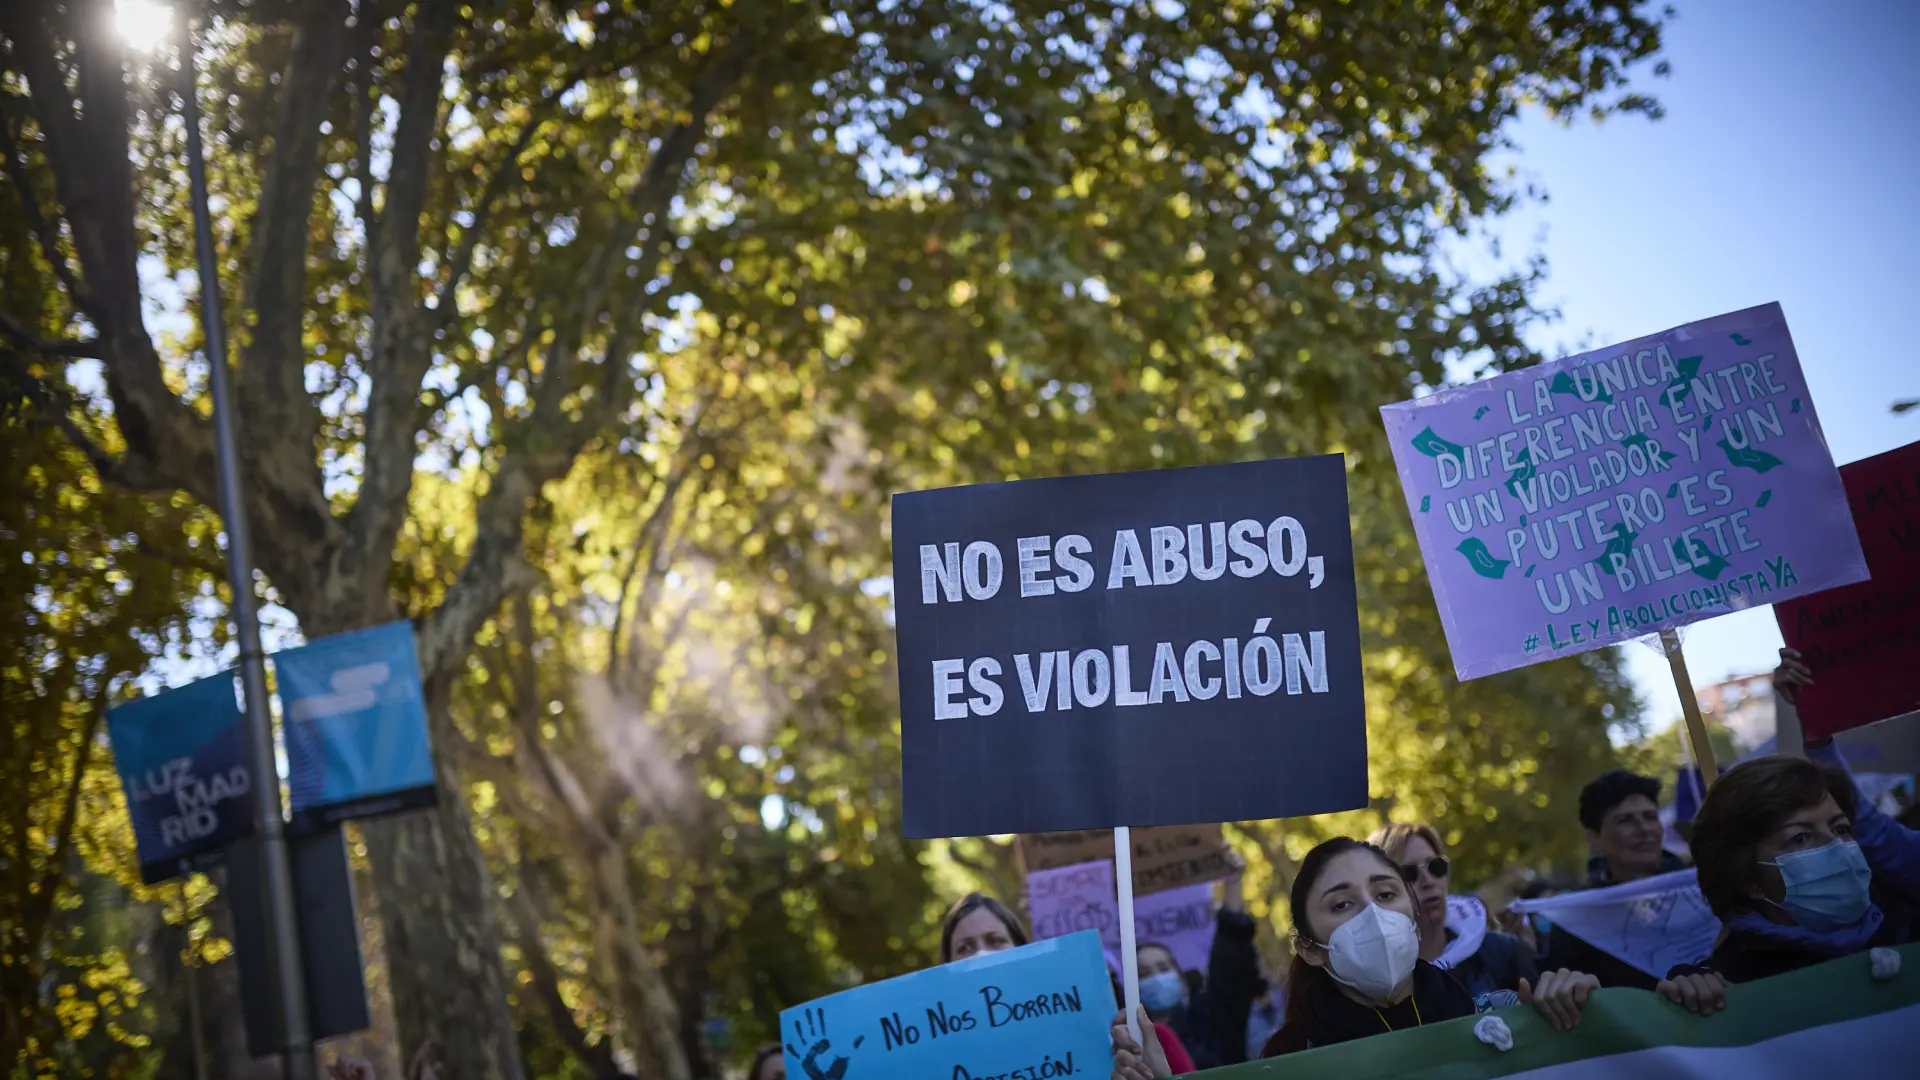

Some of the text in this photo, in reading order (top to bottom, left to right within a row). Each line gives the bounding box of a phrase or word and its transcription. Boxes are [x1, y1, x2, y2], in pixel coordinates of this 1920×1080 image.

[1436, 353, 1787, 489] DIFERENCIA ENTRE
[1505, 343, 1680, 425] LA ÚNICA
[1445, 402, 1784, 533] UN VIOLADOR Y UN
[919, 515, 1325, 604] NO ES ABUSO,
[1506, 469, 1733, 568] PUTERO ES
[1535, 509, 1761, 614] UN BILLETE
[932, 617, 1329, 720] ES VIOLACIÓN
[128, 756, 193, 801] LUZ
